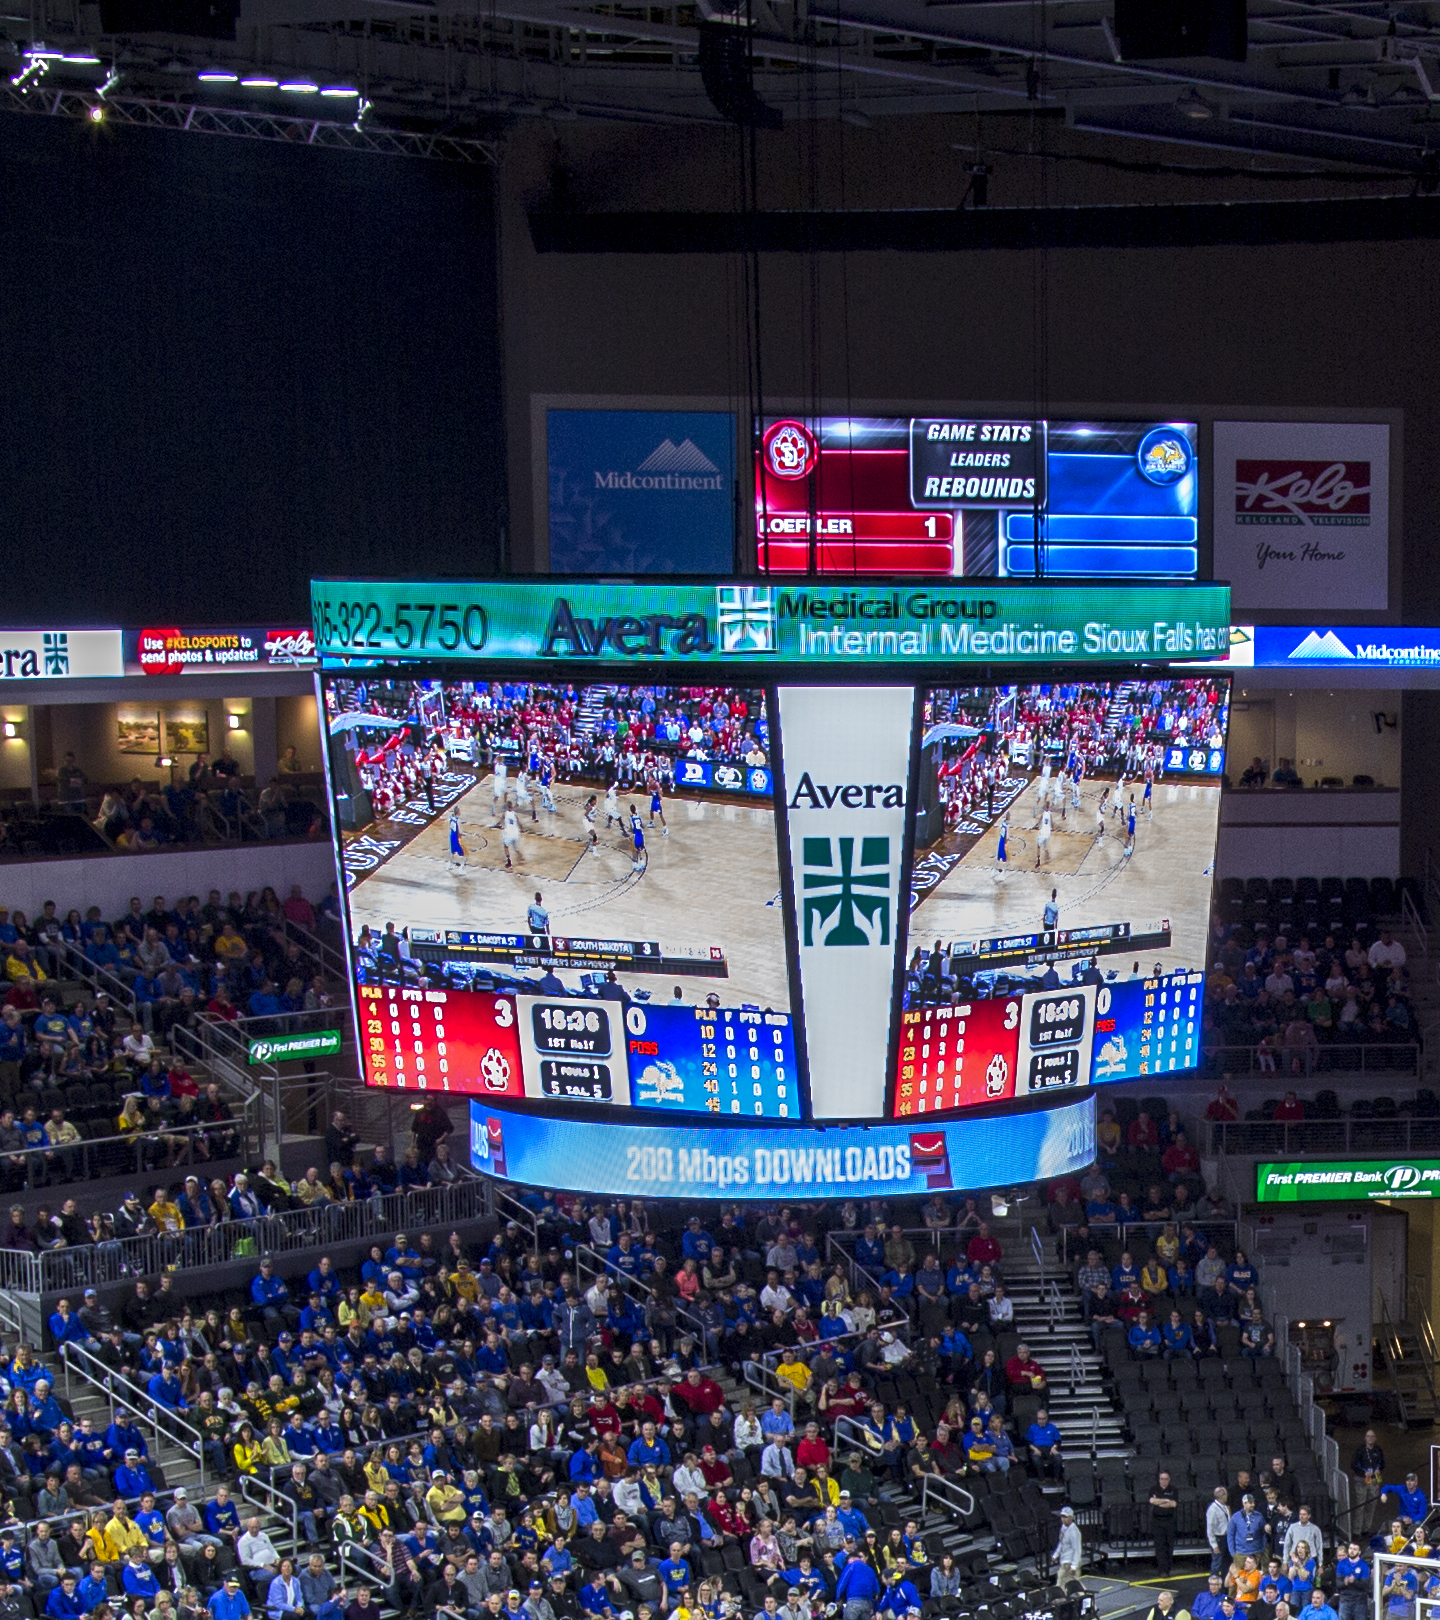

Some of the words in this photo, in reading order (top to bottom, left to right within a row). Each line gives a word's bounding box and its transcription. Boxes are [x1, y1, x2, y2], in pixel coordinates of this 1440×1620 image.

[927, 425, 976, 442] GAME
[980, 425, 1032, 443] STATS
[950, 452, 1011, 468] LEADERS
[594, 470, 724, 491] Midcontinent
[924, 478, 1036, 499] REBOUNDS
[1256, 543, 1295, 569] Your
[1300, 545, 1346, 562] Home
[777, 592, 899, 620] Medical
[904, 592, 998, 625] Group
[537, 598, 715, 657] Avera
[799, 622, 929, 655] Internal
[940, 622, 1076, 655] Medicine
[1081, 622, 1148, 654] Sioux
[1152, 621, 1192, 652] Falls
[143, 637, 164, 650] Use
[165, 635, 239, 650] #KELOSPORTS
[240, 636, 252, 648] to
[141, 651, 166, 664] send
[168, 650, 203, 666] photos
[215, 649, 259, 665] updates!
[789, 772, 906, 811] Avera
[495, 999, 514, 1028] 3
[1097, 987, 1112, 1015] 0
[541, 1008, 600, 1032] 18:36
[626, 1006, 647, 1035] 0
[1003, 1001, 1019, 1030] 3
[627, 1145, 674, 1182] 200
[678, 1147, 749, 1187] Mbps
[754, 1143, 912, 1186] DOWNLOADS
[1266, 1173, 1293, 1185] First
[1294, 1171, 1353, 1184] PREMIER
[1354, 1171, 1383, 1183] Bank
